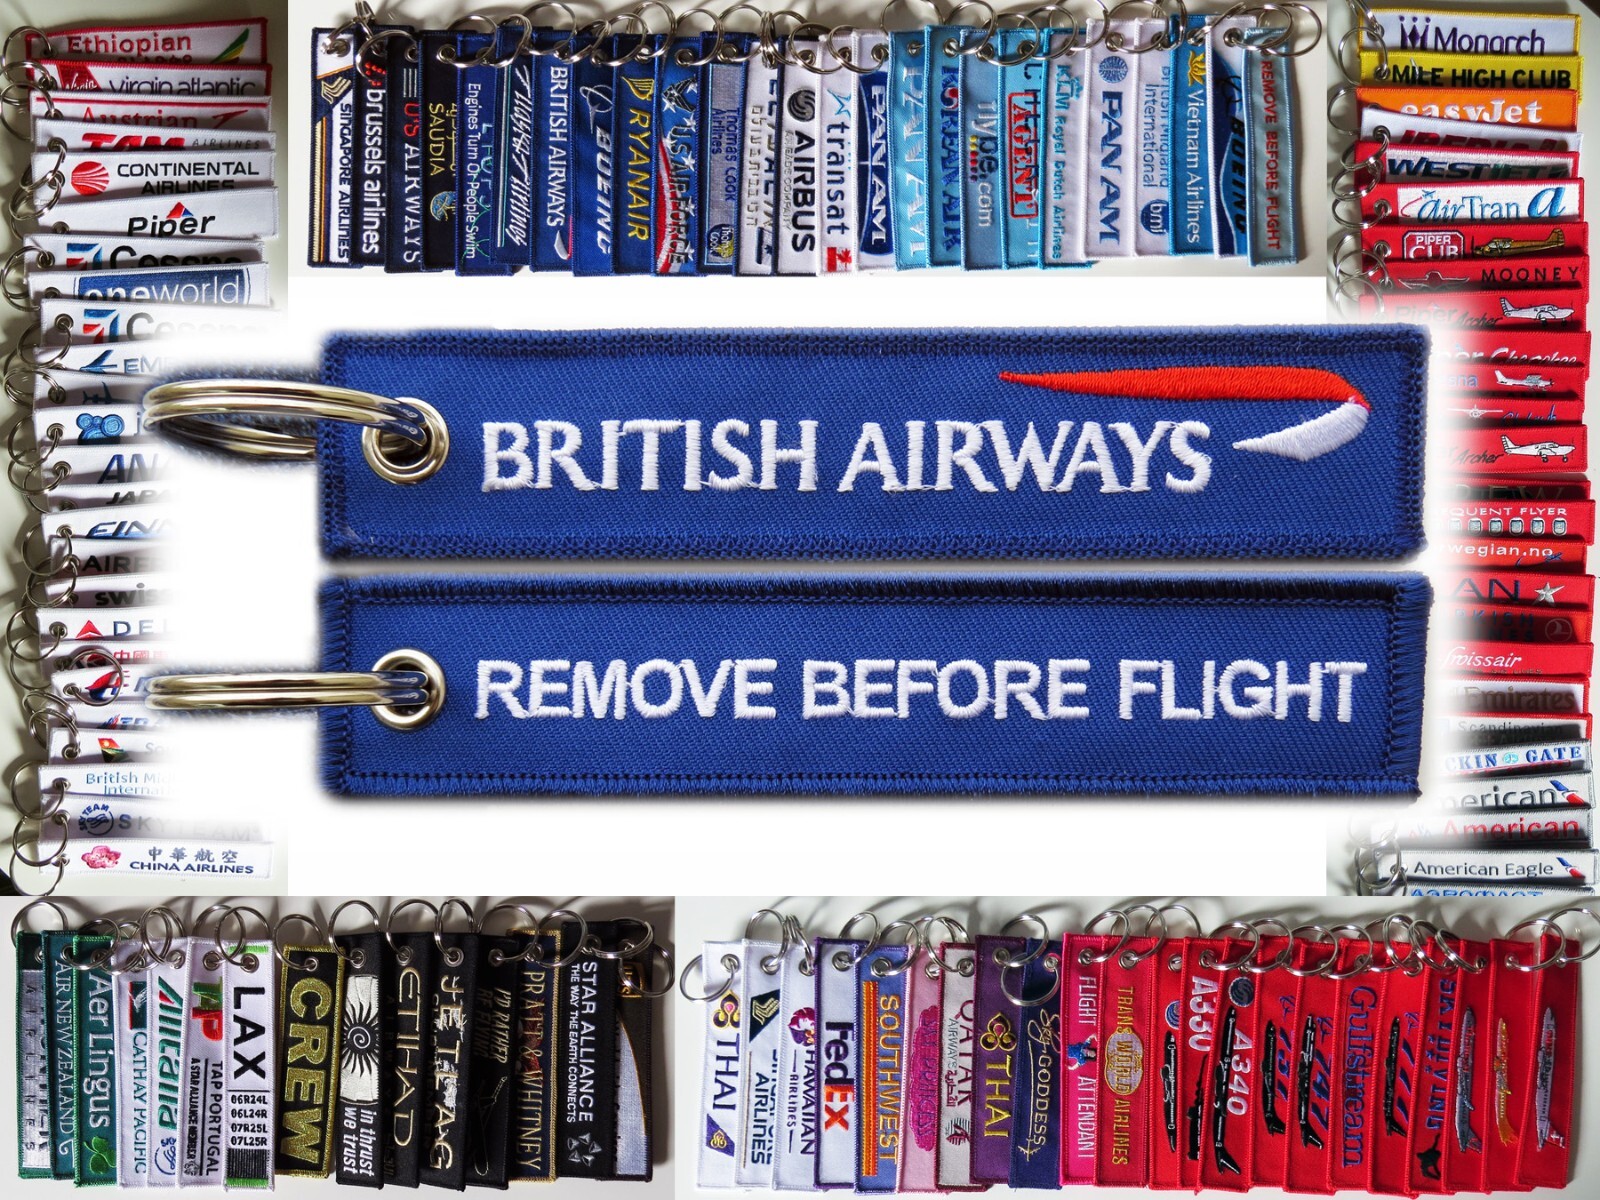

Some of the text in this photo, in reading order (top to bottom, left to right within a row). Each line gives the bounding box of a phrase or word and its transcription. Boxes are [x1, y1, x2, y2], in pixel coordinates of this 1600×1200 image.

[67, 33, 191, 57] Ethiopian
[1392, 65, 1571, 89] MILE HIGH CLUB
[1435, 26, 1545, 55] Monarch
[82, 107, 198, 129] Austrian
[178, 77, 256, 96] atlantic
[902, 66, 924, 164] PAN
[1400, 99, 1542, 124] easyJet
[117, 161, 259, 177] CONTINENTAL
[192, 132, 260, 149] AIRLINES
[429, 102, 445, 176] SAUDIA
[547, 66, 568, 227] BRITISH AIRWAYS
[711, 108, 725, 155] Airlines
[871, 85, 888, 246] PAN AM
[1012, 103, 1038, 208] AGENT
[1052, 65, 1071, 260] KLM Royal Dutch Airlines
[1099, 91, 1123, 246] PAN AM
[1142, 83, 1158, 188] International
[1187, 89, 1205, 244] Vietnam Airlines
[1261, 60, 1281, 250] REMOVE BEFORE FLIGHT
[142, 180, 235, 195] AIRLINES
[362, 88, 387, 254] brussels airlines
[403, 143, 421, 263] AIRWAYS
[464, 83, 481, 259] Engines Turn Or People Swim
[596, 125, 612, 255] BOEING
[627, 109, 650, 241] RYANAIR
[791, 130, 816, 253] AIRBUS
[826, 121, 850, 235] transat
[1417, 196, 1519, 221] airTran
[127, 214, 215, 237] Piper
[667, 196, 690, 264] FORCE
[1149, 202, 1166, 236] bmi
[1416, 234, 1451, 246] PIPER
[85, 275, 240, 304] oneworld
[1481, 266, 1580, 284] MOONEY
[482, 418, 1212, 493] BRITISH AIRWAYS
[1520, 507, 1567, 517] FLYER
[475, 658, 1368, 723] REMOVE BEFORE FLIGHT
[1464, 686, 1575, 711] Emirates
[86, 771, 138, 784] British
[1526, 746, 1581, 763] GATE
[148, 846, 238, 864] 中華航空
[1443, 817, 1580, 841] American
[130, 861, 254, 874] CHINA AIRLINES
[1414, 861, 1553, 878] American Eagle
[233, 987, 266, 1080] LAX
[488, 987, 511, 1064] I'D RATHER
[1078, 976, 1097, 1026] FLIGHT
[1188, 975, 1218, 1052] A330
[23, 986, 38, 1151] AIRLINES
[54, 960, 74, 1134] AIR NEW ZEALAND
[83, 972, 113, 1129] Aer Lingus
[190, 1065, 200, 1085] STAR
[280, 977, 332, 1164] CREW
[393, 967, 421, 1147] ETIHAD
[517, 970, 546, 1171] PRATT & WHITNEY
[566, 964, 580, 1123] THE WAY THE EARTH CONNECTS
[578, 961, 598, 1122] STAR ALLIANCE
[712, 1033, 740, 1111] THAI
[823, 1021, 855, 1132] FedEx
[878, 994, 901, 1164] SOUTHWEST
[947, 1019, 959, 1069] AIRWAYS
[955, 1000, 974, 1106] QATAR
[1112, 986, 1134, 1165] TRANS WORLD AIRLINES
[1227, 1028, 1253, 1116] A340
[1344, 986, 1378, 1168] Gulfstream
[132, 1032, 147, 1174] CATHAY PACIFIC
[188, 1086, 200, 1125] ALLIANCE
[205, 1060, 223, 1176] TAP PORTUGAL
[231, 1095, 267, 1105] 06R24L
[231, 1109, 267, 1119] 06L24R
[231, 1123, 267, 1133] 07R25L
[751, 1072, 769, 1164] AIRLINES
[786, 1074, 799, 1128] AIRLINES
[800, 1050, 816, 1155] HAWAIIAN
[984, 1055, 1014, 1138] THAI
[1033, 1054, 1054, 1146] GODDESS
[187, 1126, 198, 1159] MEMBER
[231, 1136, 267, 1147] 07L25R
[343, 1107, 358, 1174] we trust
[359, 1109, 377, 1177] in thrust
